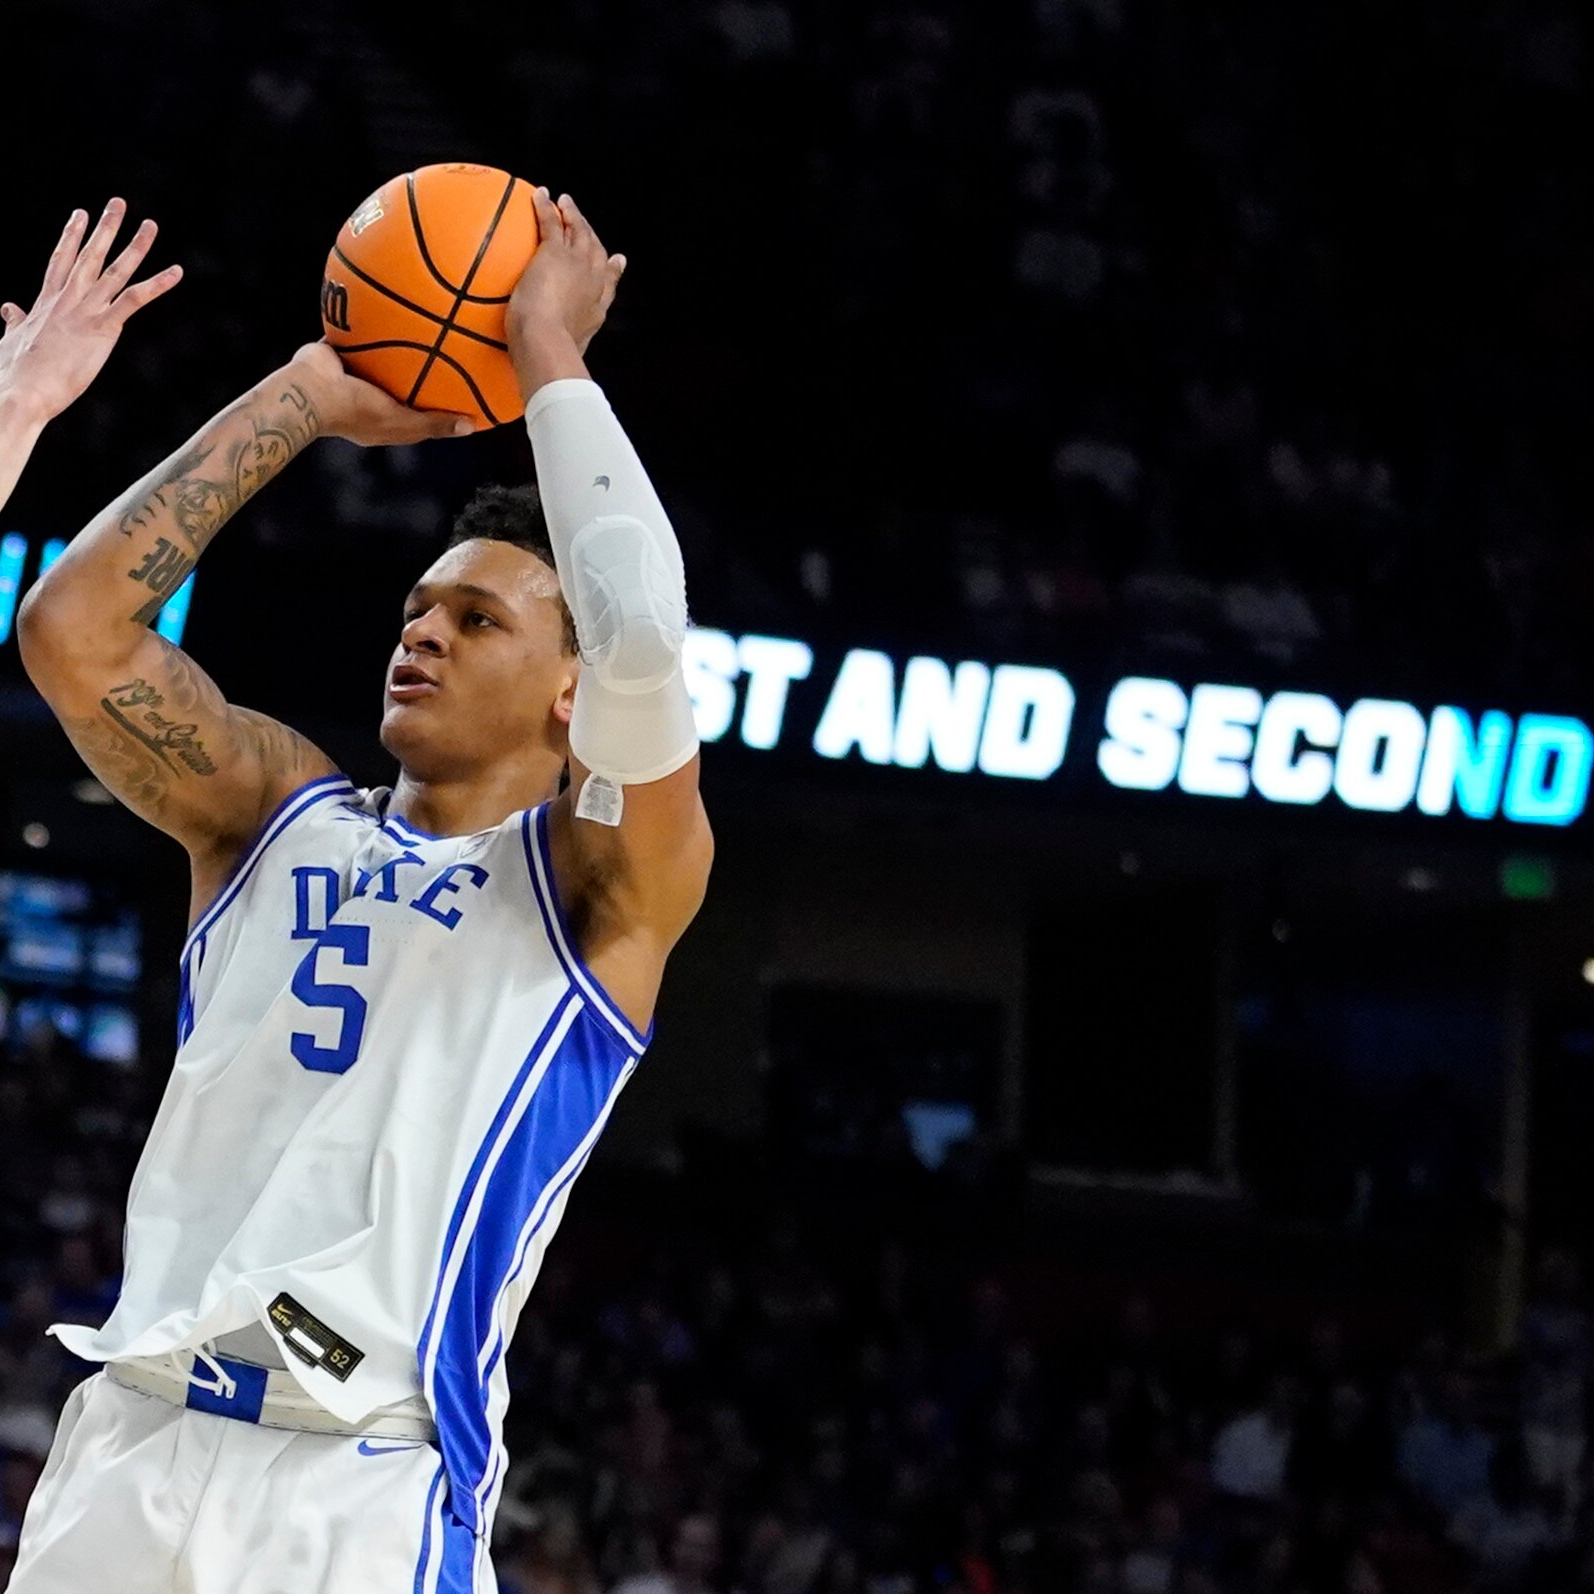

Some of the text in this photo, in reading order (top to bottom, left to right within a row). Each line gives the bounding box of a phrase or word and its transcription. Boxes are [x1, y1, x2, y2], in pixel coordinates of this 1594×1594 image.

[812, 647, 1076, 781] AND
[1096, 675, 1594, 828] SECOND
[291, 924, 370, 1075] 5
